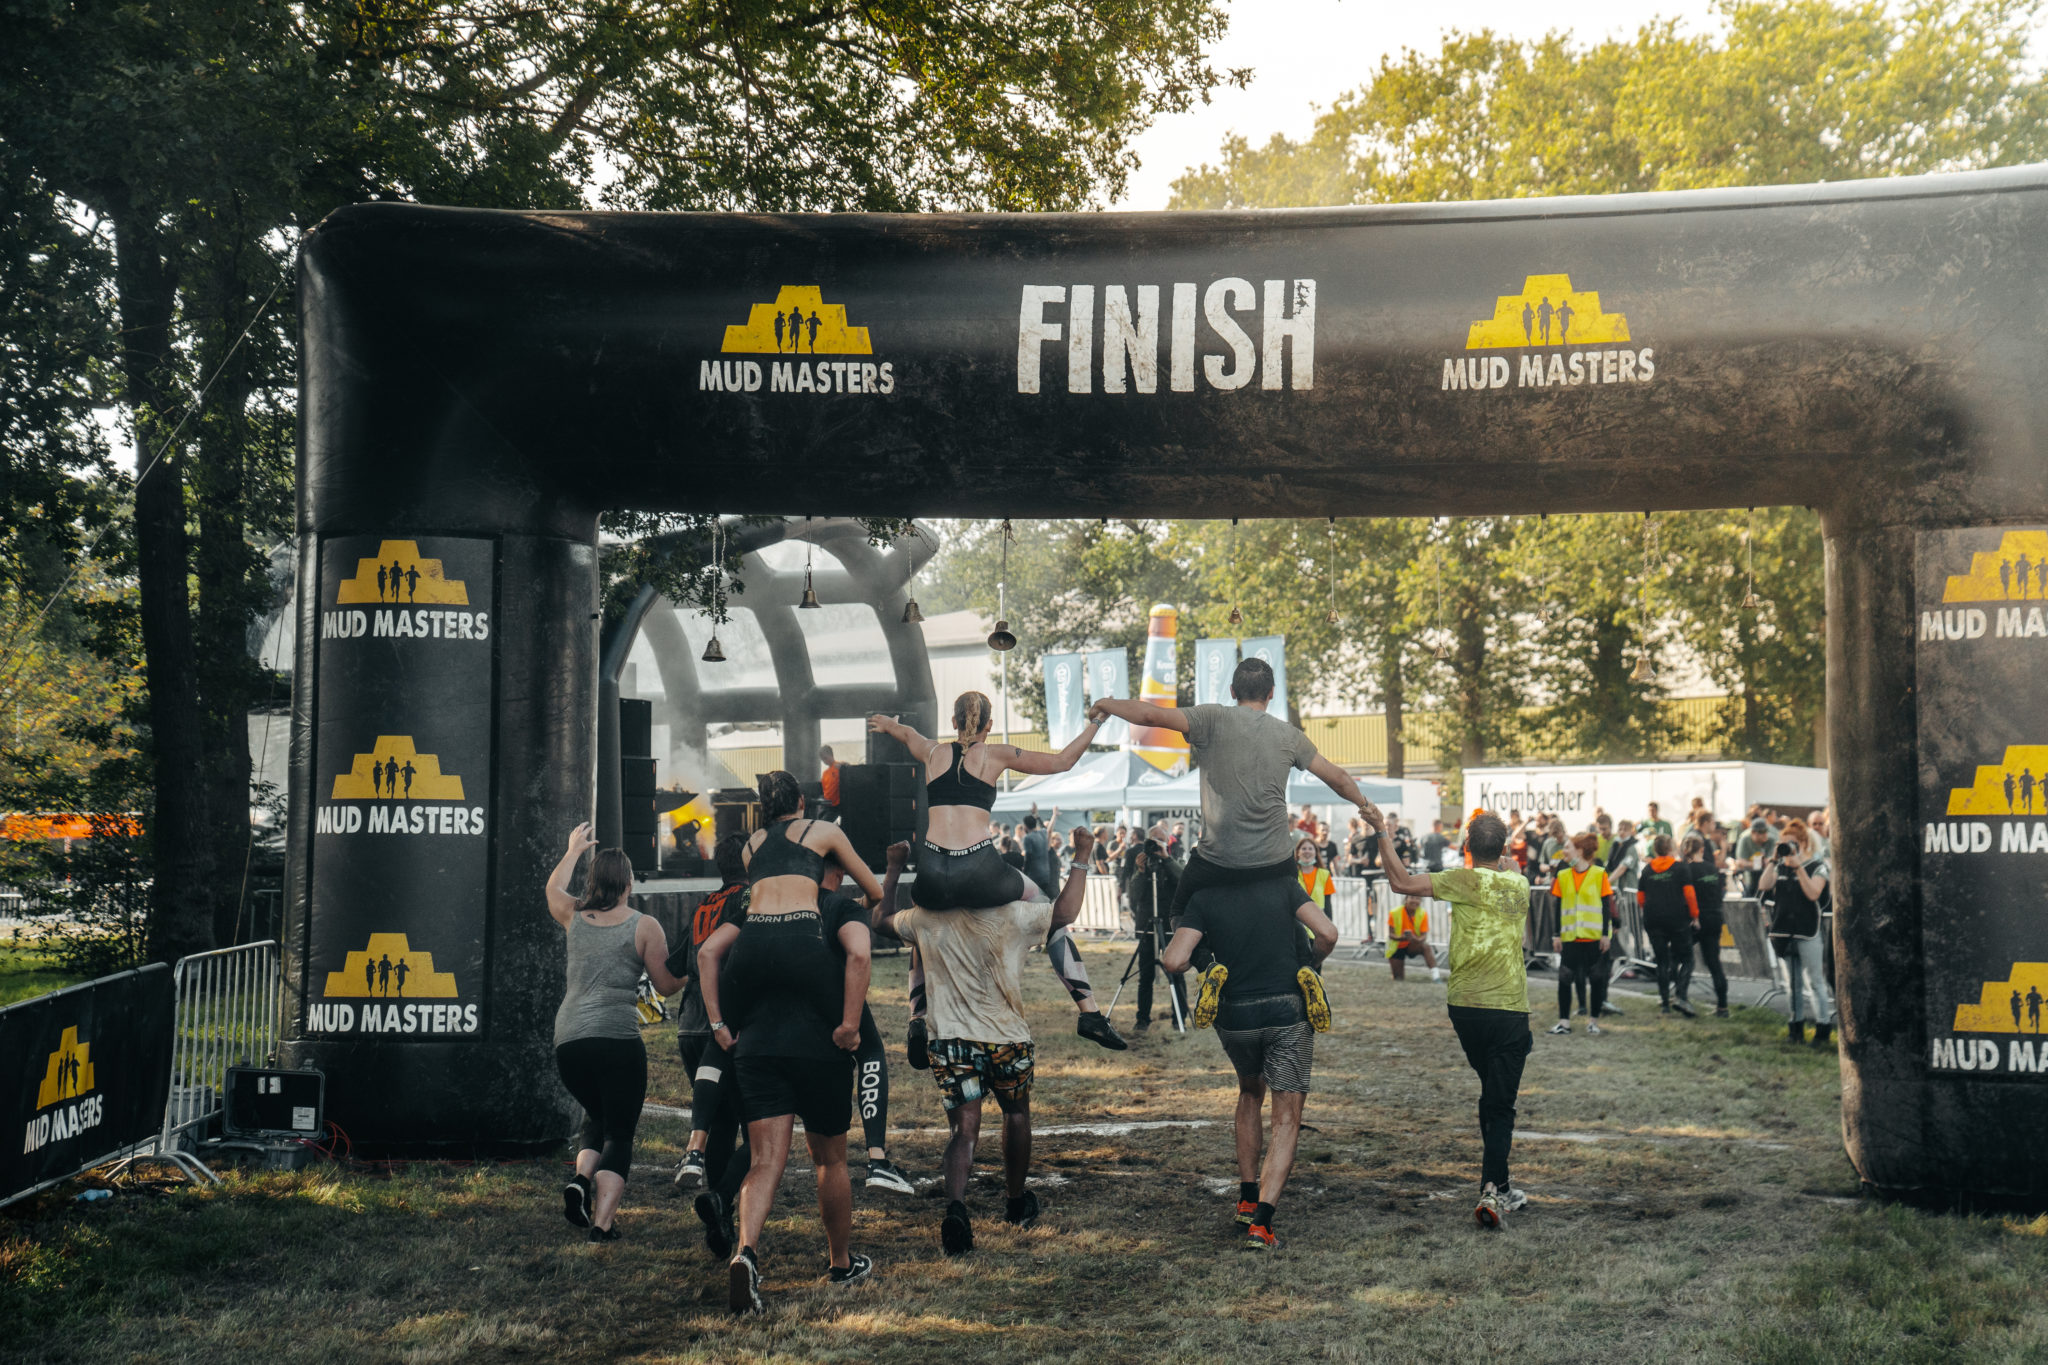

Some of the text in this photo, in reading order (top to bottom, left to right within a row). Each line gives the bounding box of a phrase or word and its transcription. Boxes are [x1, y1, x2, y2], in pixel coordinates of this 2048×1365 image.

[1017, 277, 1317, 394] FINISH
[699, 360, 895, 394] MUD MASTERS
[1441, 347, 1655, 391] MUD MASTERS
[322, 609, 489, 641] MUD MASTERS
[1920, 606, 2048, 642] MUD MA
[1480, 781, 1586, 812] Krombacher
[316, 805, 485, 836] MUD MASTERS
[1924, 821, 2048, 854] MUD MA
[784, 911, 817, 922] BORG
[307, 1003, 478, 1034] MUD MASTERS
[1932, 1037, 2000, 1071] MUD
[861, 1060, 881, 1120] BORG
